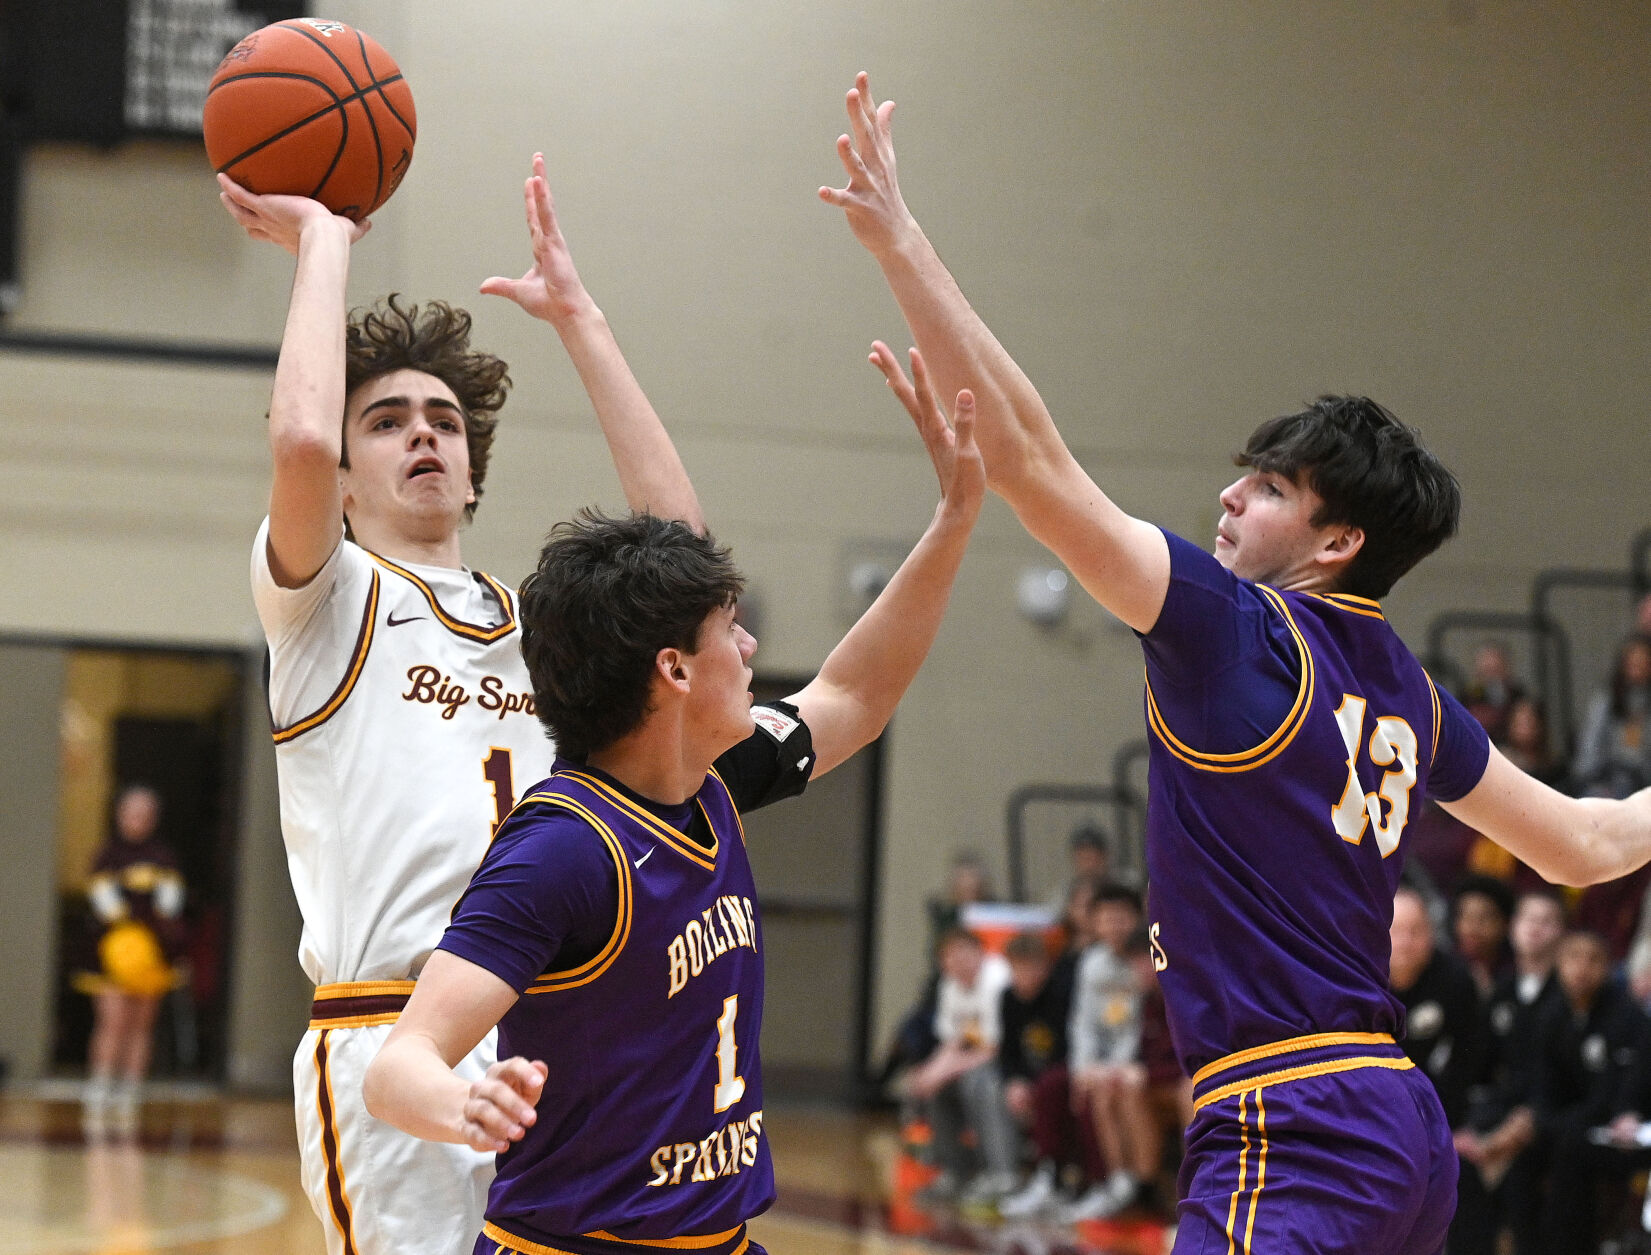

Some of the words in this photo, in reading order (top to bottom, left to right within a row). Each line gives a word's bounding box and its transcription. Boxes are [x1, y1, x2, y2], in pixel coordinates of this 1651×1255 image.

[402, 665, 471, 720] Big
[478, 676, 539, 720] Spr
[481, 745, 518, 839] 1
[1331, 693, 1419, 859] 13
[668, 895, 758, 999] BOILING
[714, 994, 745, 1114] 1
